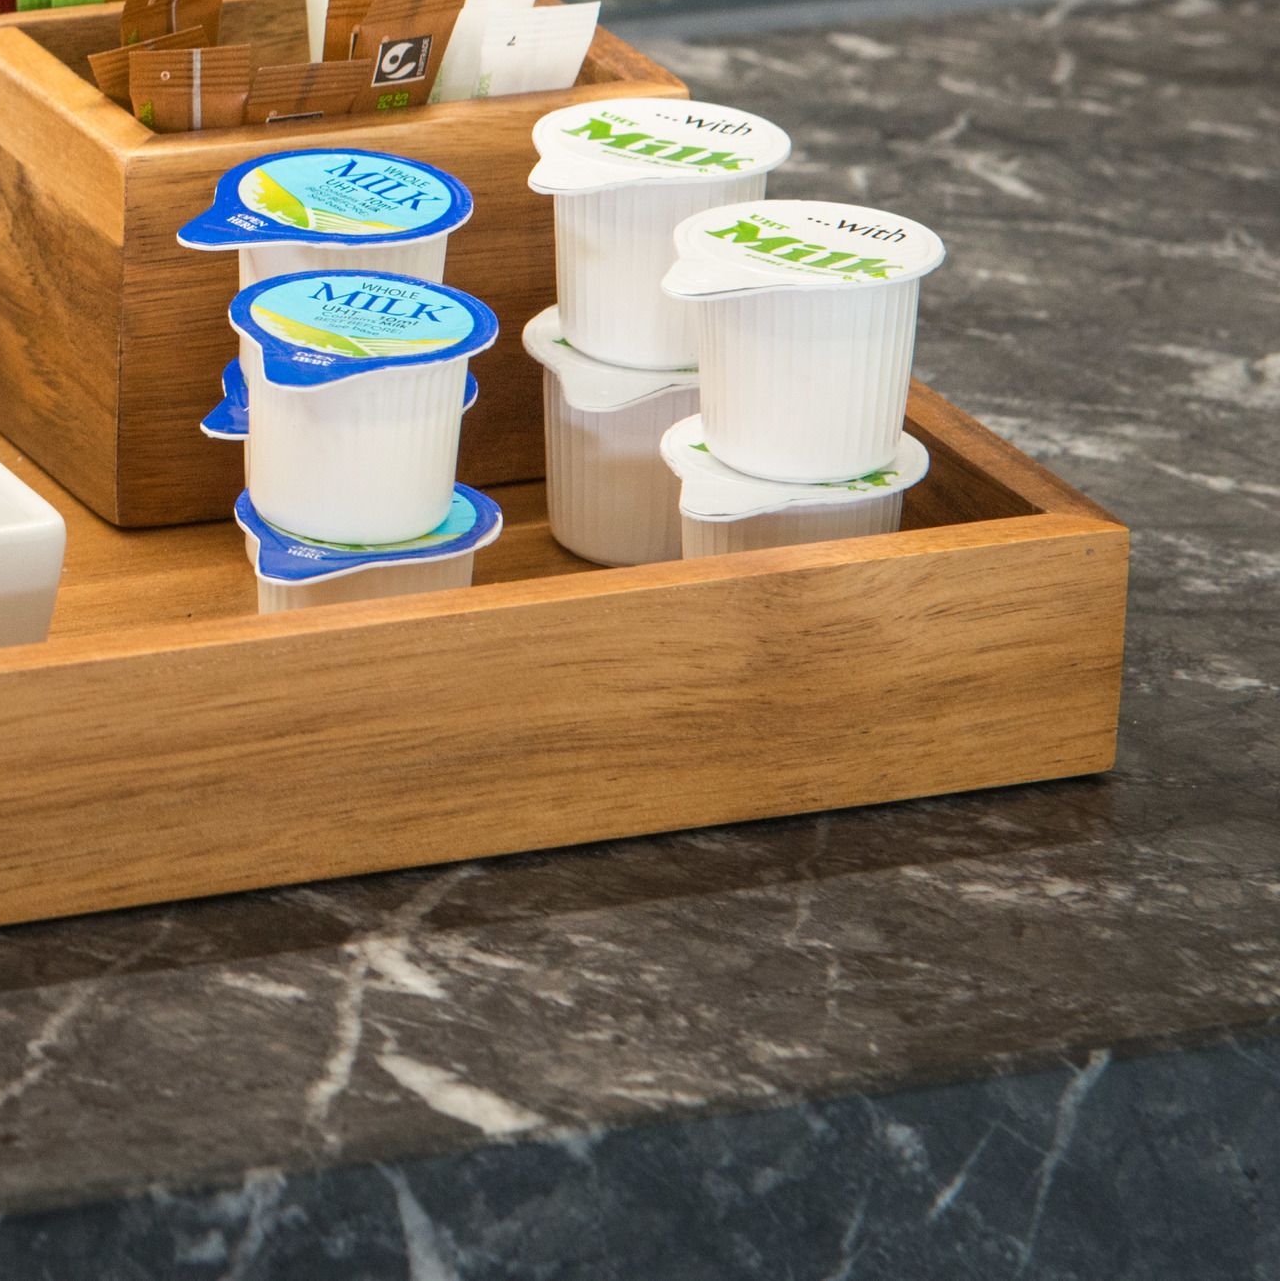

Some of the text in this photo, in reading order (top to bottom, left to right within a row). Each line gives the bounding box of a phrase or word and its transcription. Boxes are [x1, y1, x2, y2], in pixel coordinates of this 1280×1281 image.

[560, 117, 754, 170] Milk
[324, 159, 443, 211] MILK
[326, 179, 358, 193] UHT
[383, 166, 430, 189] WHOLE
[749, 214, 791, 231] UHT
[704, 219, 903, 280] Milk
[308, 281, 455, 323] MILK
[361, 282, 419, 300] WHOLE
[322, 304, 419, 326] UHT 10ml
